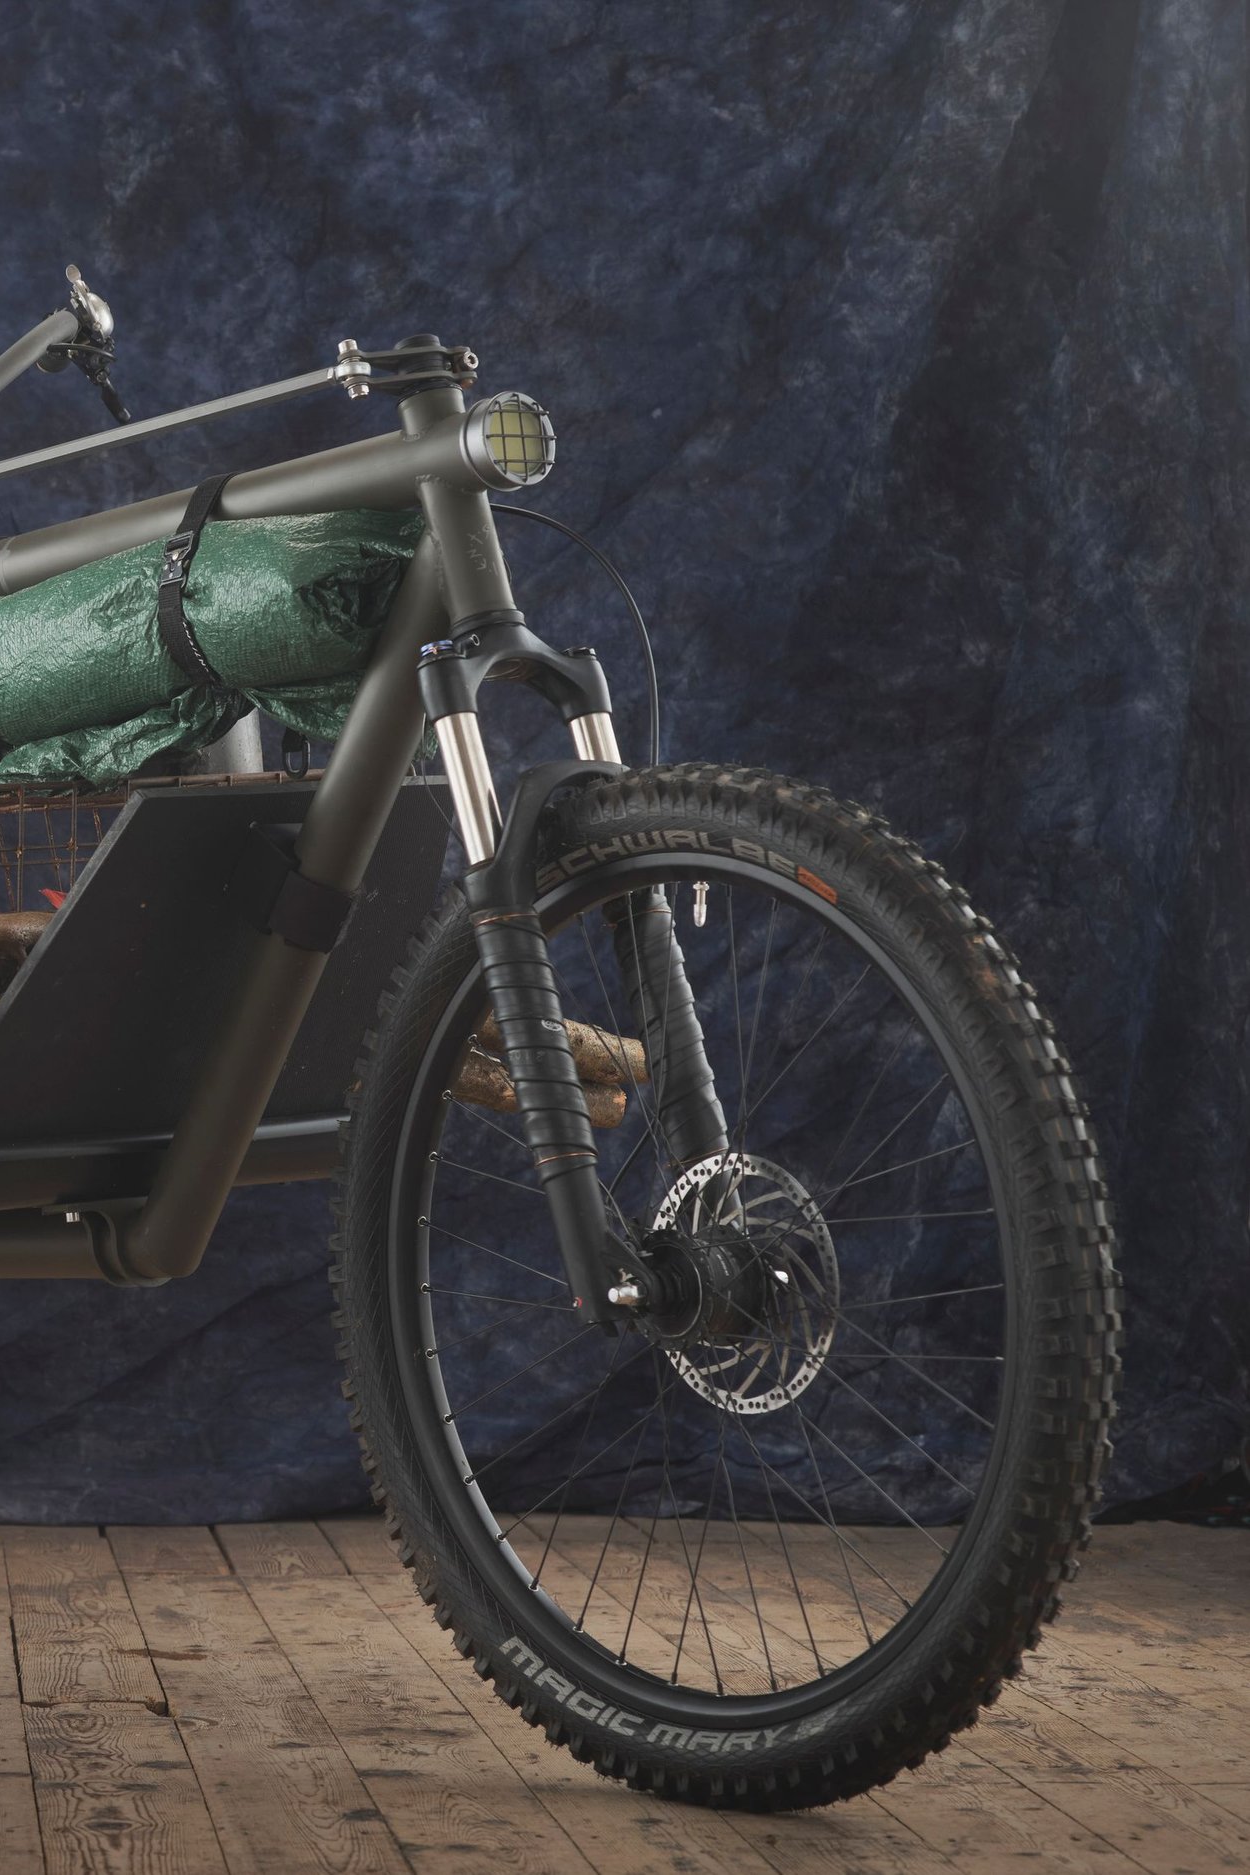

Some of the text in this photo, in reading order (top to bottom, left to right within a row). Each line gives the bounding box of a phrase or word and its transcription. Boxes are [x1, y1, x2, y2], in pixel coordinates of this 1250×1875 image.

[535, 829, 797, 894] SCHWALBE
[498, 1635, 789, 1753] MAGIC MARY
